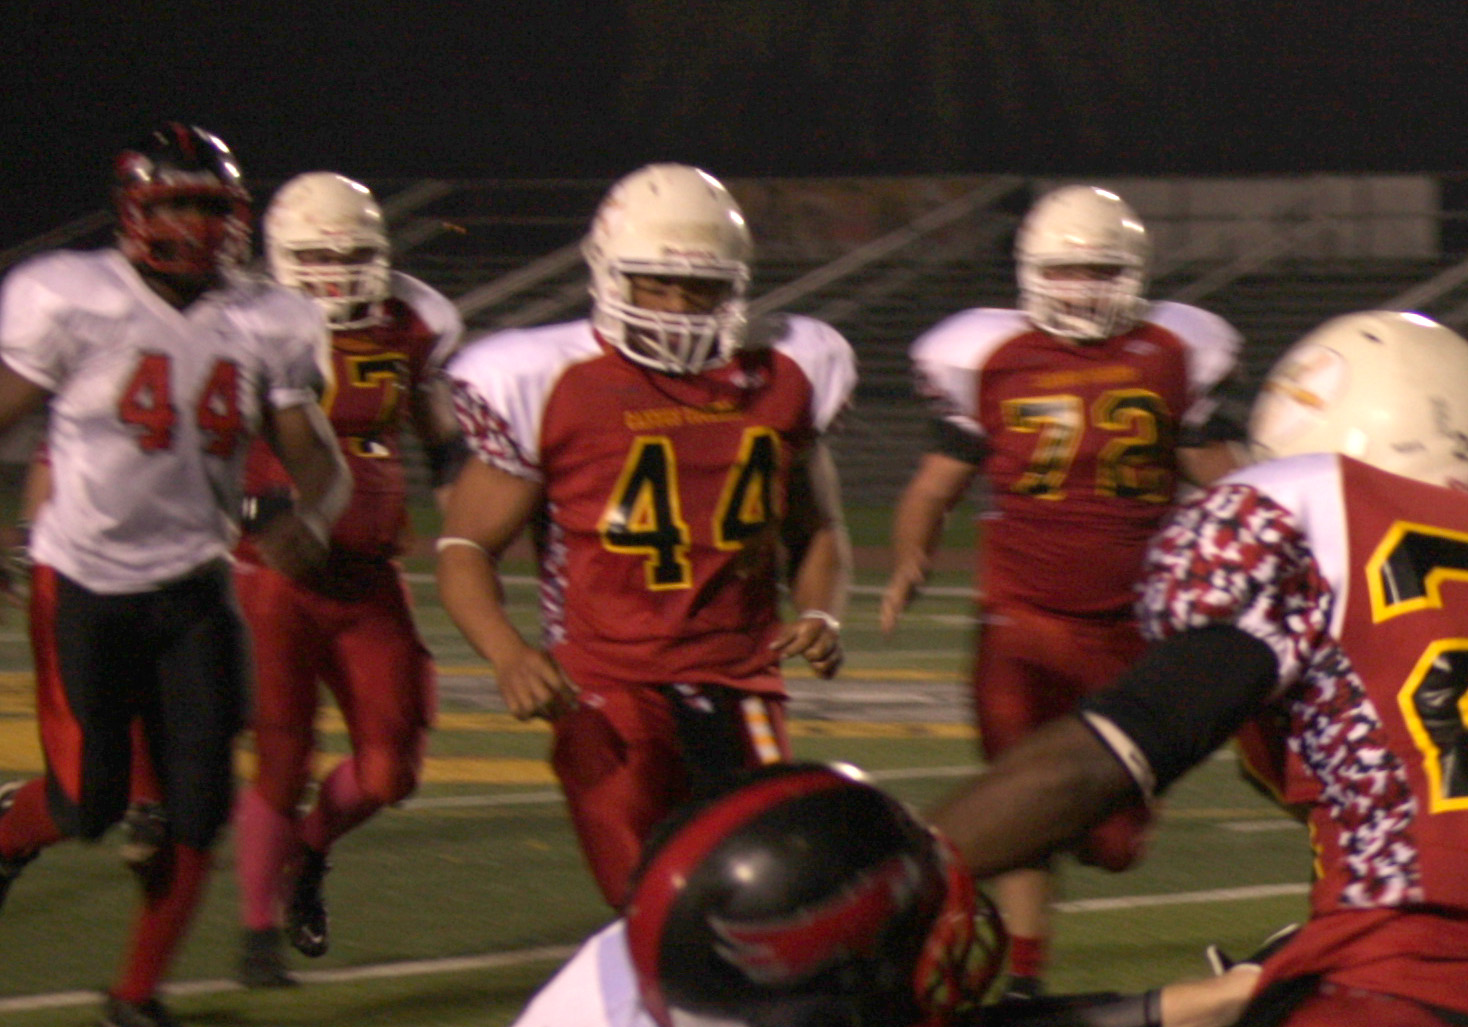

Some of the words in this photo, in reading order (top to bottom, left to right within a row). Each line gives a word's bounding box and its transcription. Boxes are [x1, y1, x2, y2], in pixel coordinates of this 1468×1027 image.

[117, 351, 242, 457] 44
[1000, 388, 1173, 502] 72
[597, 426, 783, 591] 44
